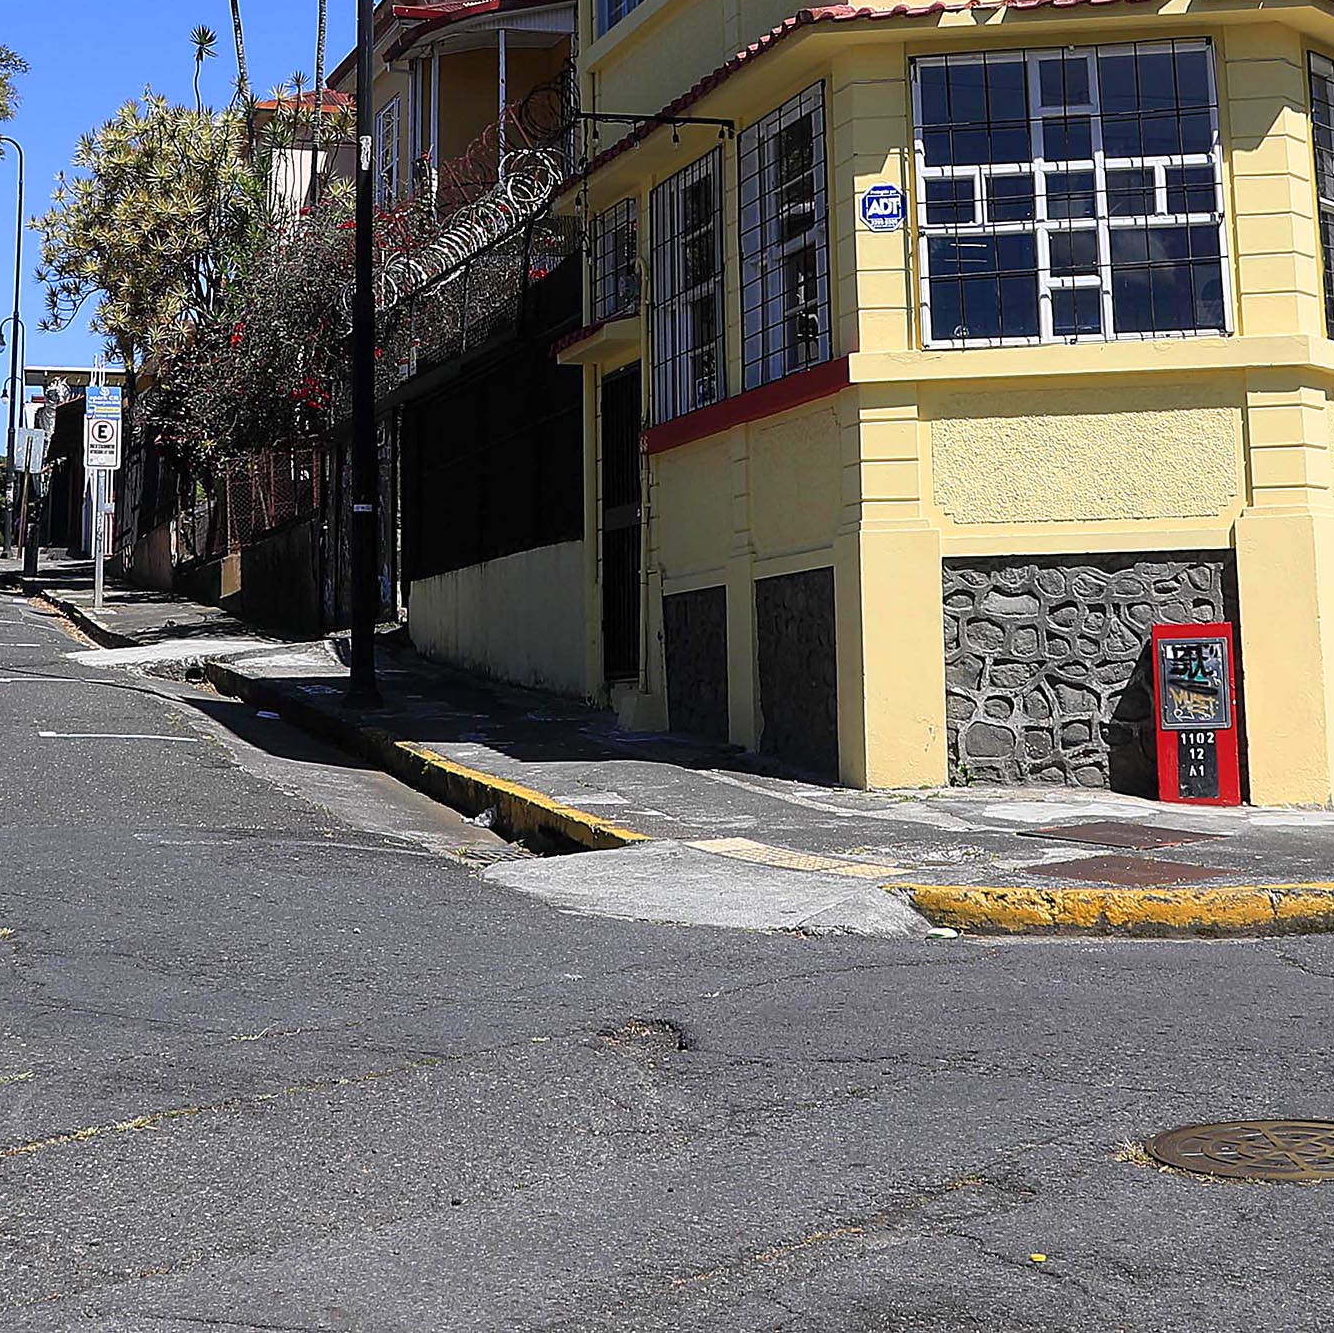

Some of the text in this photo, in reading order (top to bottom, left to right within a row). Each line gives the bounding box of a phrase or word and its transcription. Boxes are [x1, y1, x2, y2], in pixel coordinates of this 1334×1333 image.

[868, 198, 901, 215] ADT
[98, 425, 108, 439] E
[1181, 732, 1215, 745] 1102
[1189, 748, 1205, 760] 12
